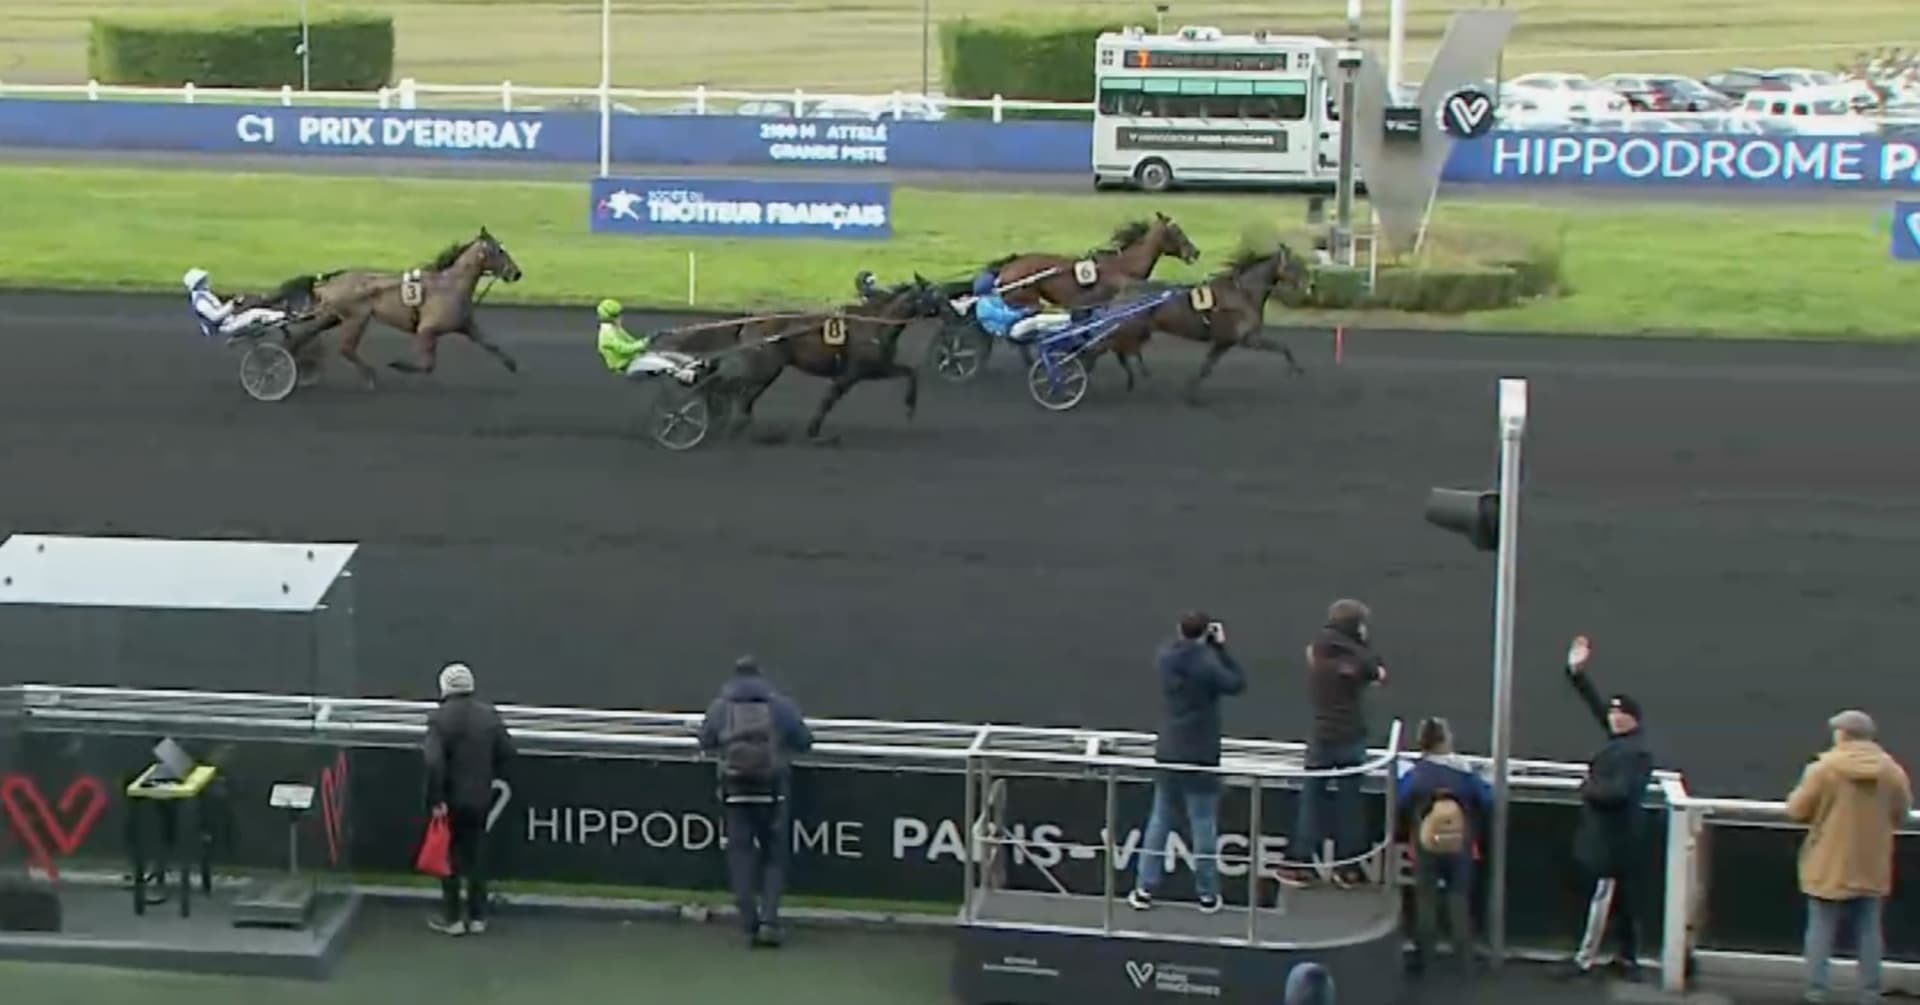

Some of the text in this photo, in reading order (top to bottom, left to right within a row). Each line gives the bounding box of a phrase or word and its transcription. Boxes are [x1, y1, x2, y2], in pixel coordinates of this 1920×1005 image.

[237, 114, 543, 149] C1 PRIX D'ERBRAY
[1493, 136, 1920, 182] HIPPODROME P
[647, 199, 886, 230] TROTTEUR FRANÇAIS
[1079, 264, 1093, 280] 6
[526, 806, 864, 858] HIPPODME
